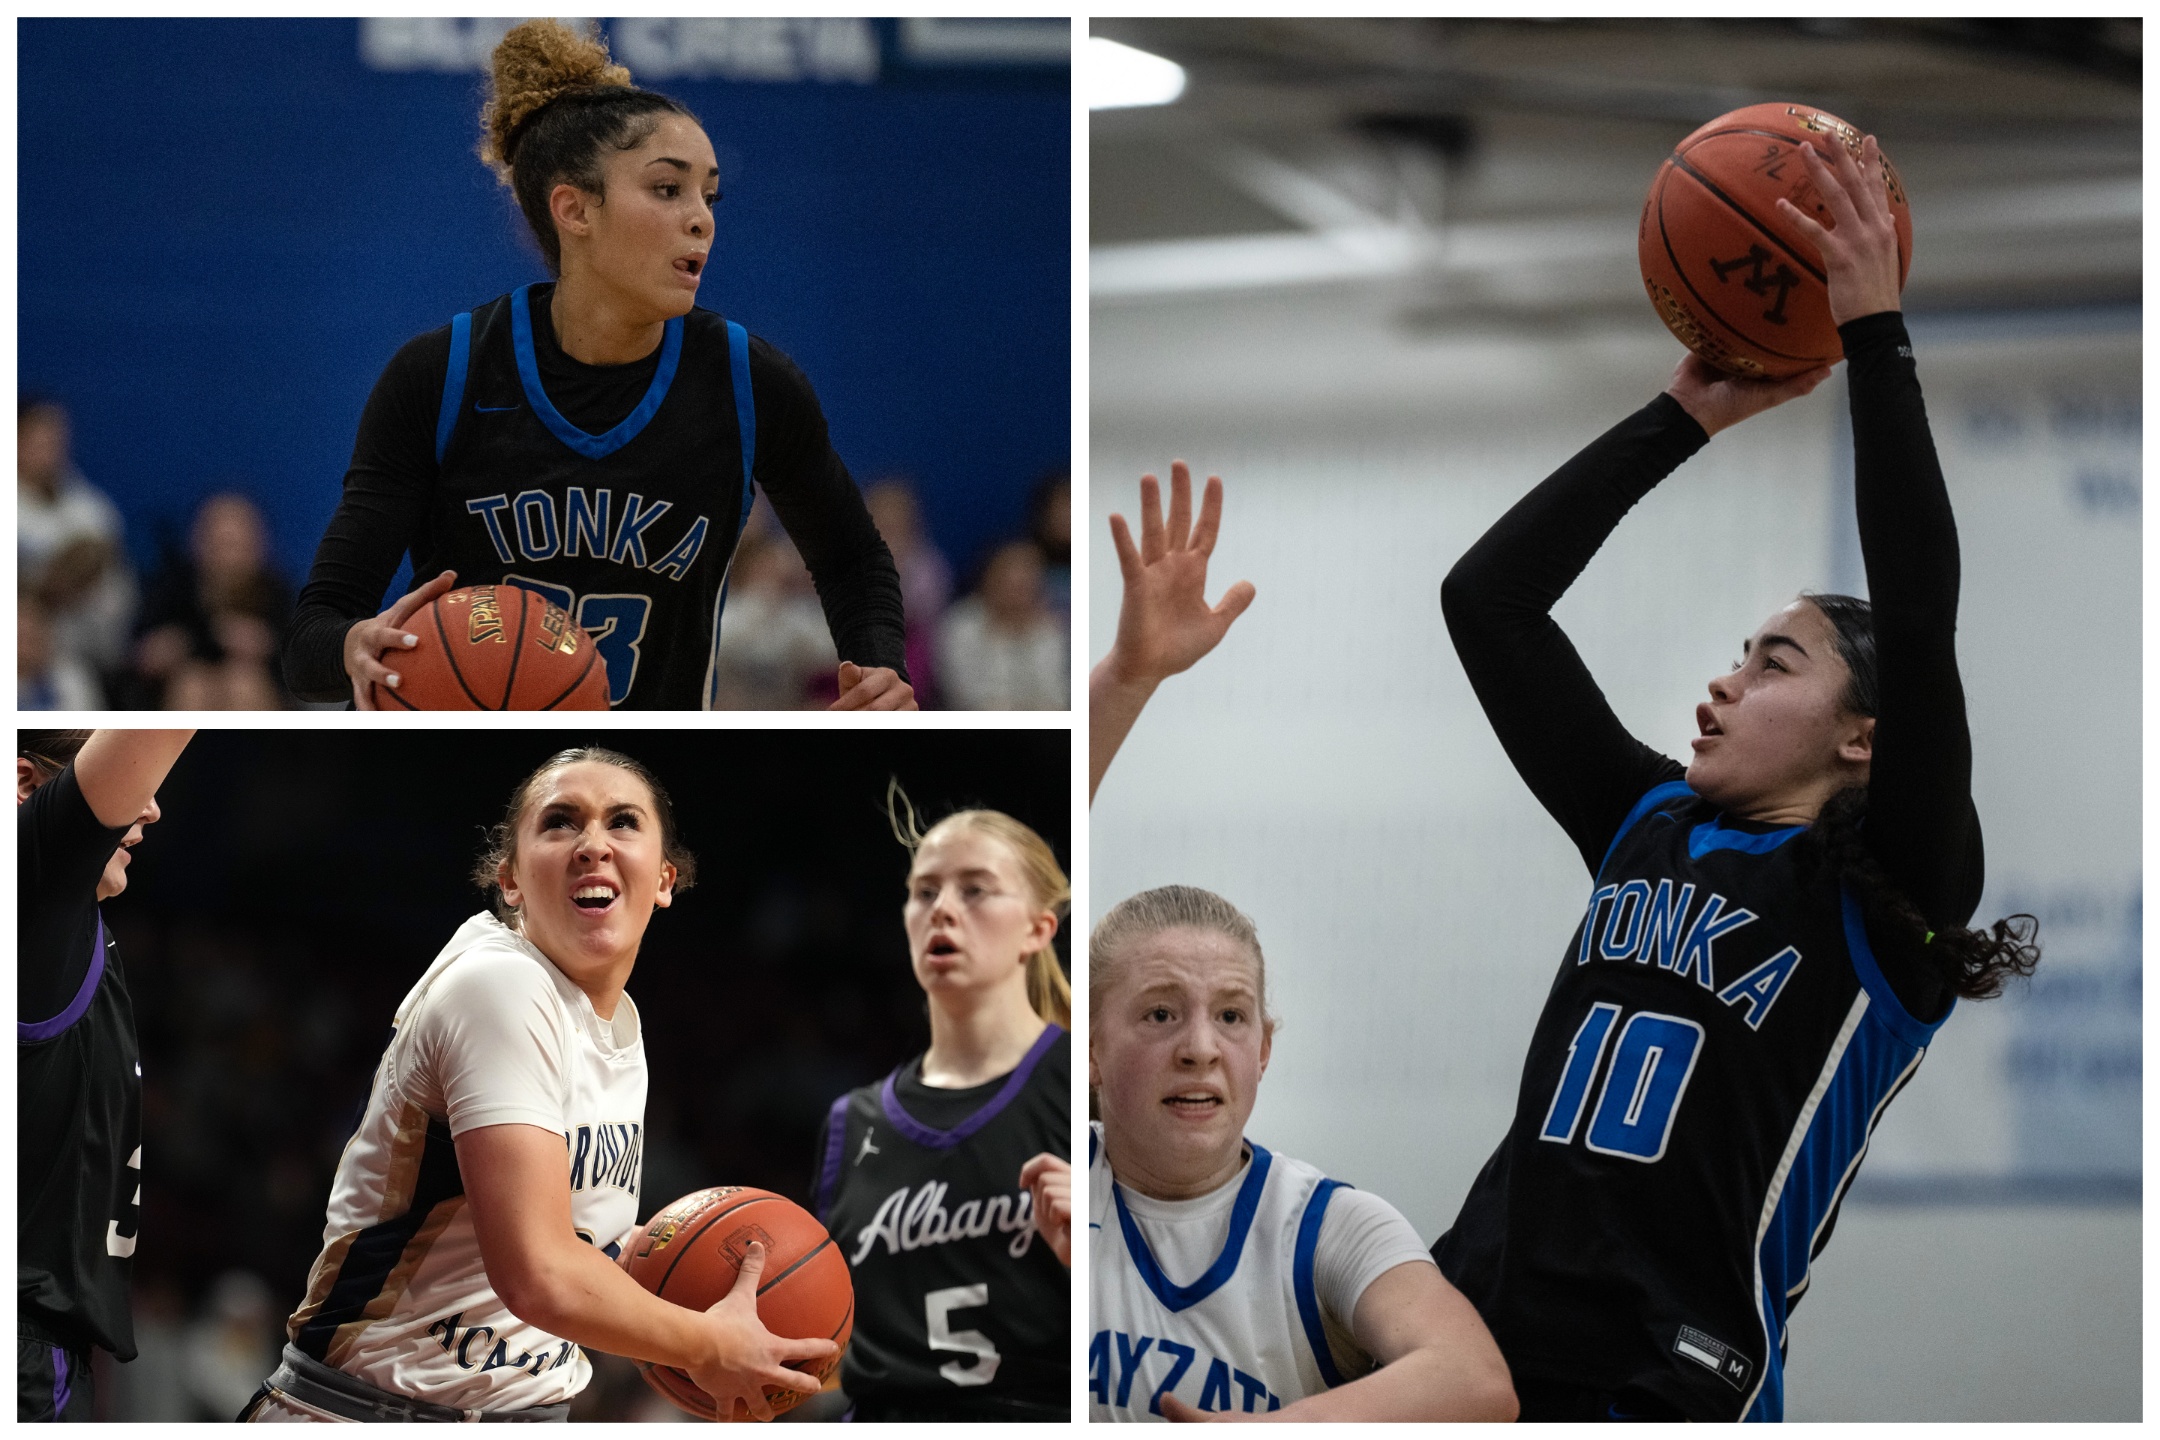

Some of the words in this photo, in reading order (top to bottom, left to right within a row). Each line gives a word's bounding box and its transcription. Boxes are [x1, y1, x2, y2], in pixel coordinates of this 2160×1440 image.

[1709, 242, 1800, 326] M
[466, 487, 709, 581] TONKA
[502, 574, 652, 706] 3
[1577, 878, 1802, 1032] TONKA
[1539, 1002, 1705, 1163] 10
[851, 1180, 1038, 1266] Albany
[925, 1282, 1001, 1387] 5
[1089, 1330, 1281, 1418] AYZAT
[1728, 1360, 1744, 1378] M
